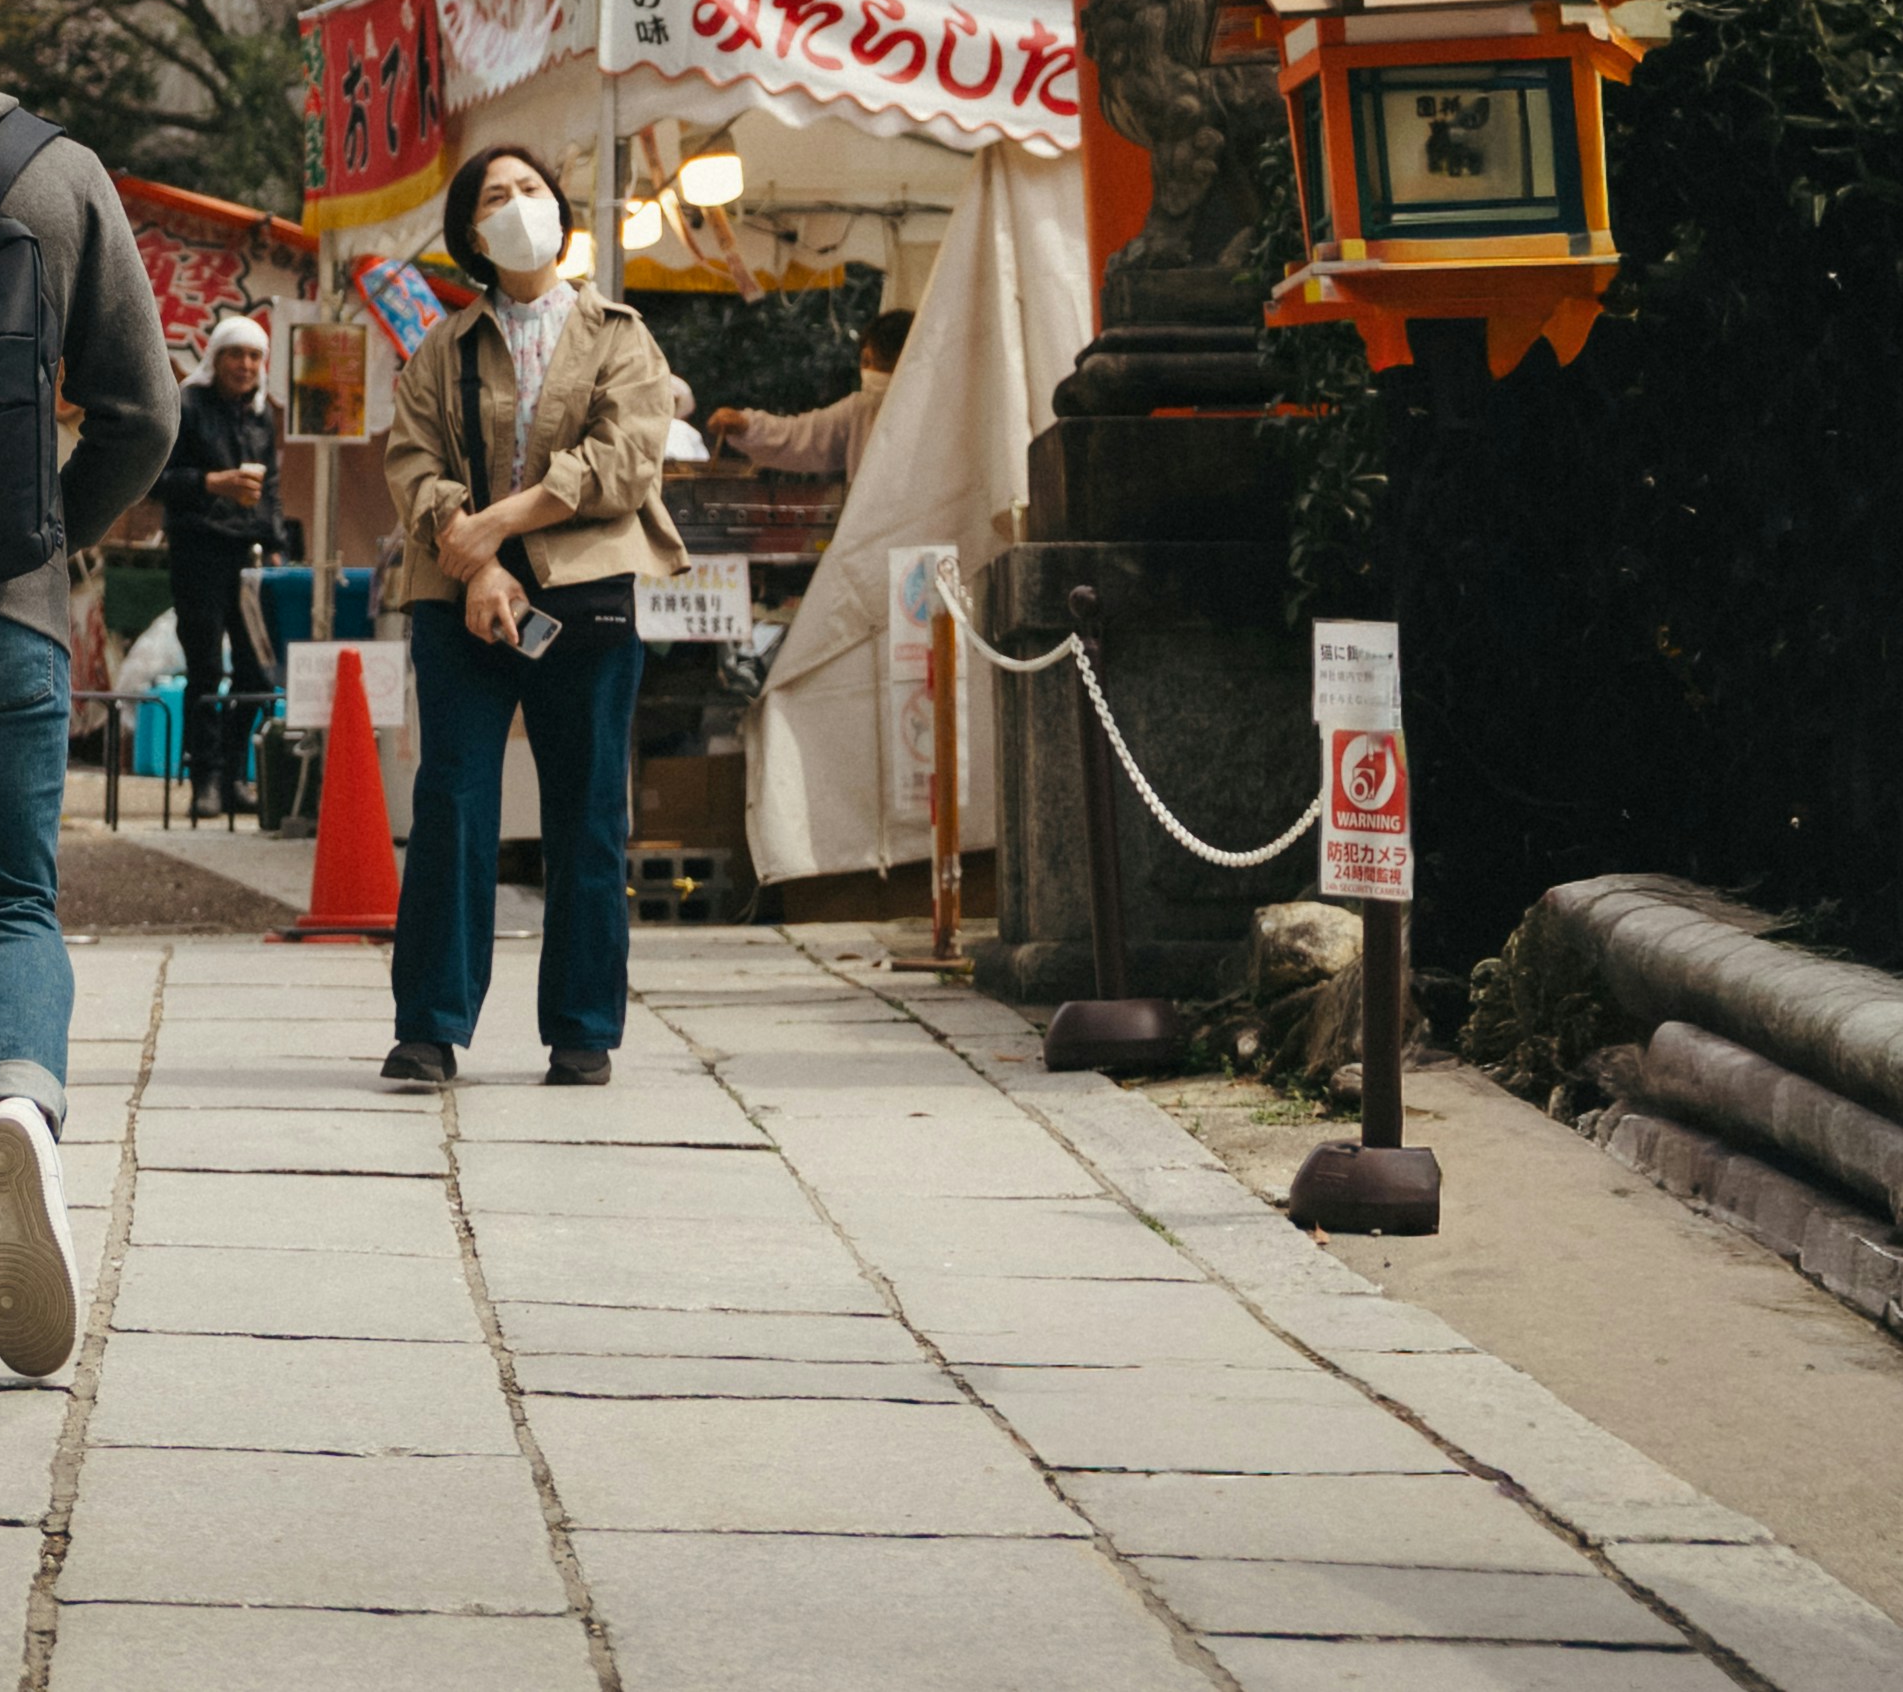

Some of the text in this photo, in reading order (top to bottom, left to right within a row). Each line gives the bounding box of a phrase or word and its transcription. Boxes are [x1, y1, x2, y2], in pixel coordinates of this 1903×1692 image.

[1336, 810, 1401, 831] WARNING
[1327, 840, 1408, 866] 防犯カメラ
[1333, 864, 1402, 885] 24時間監視
